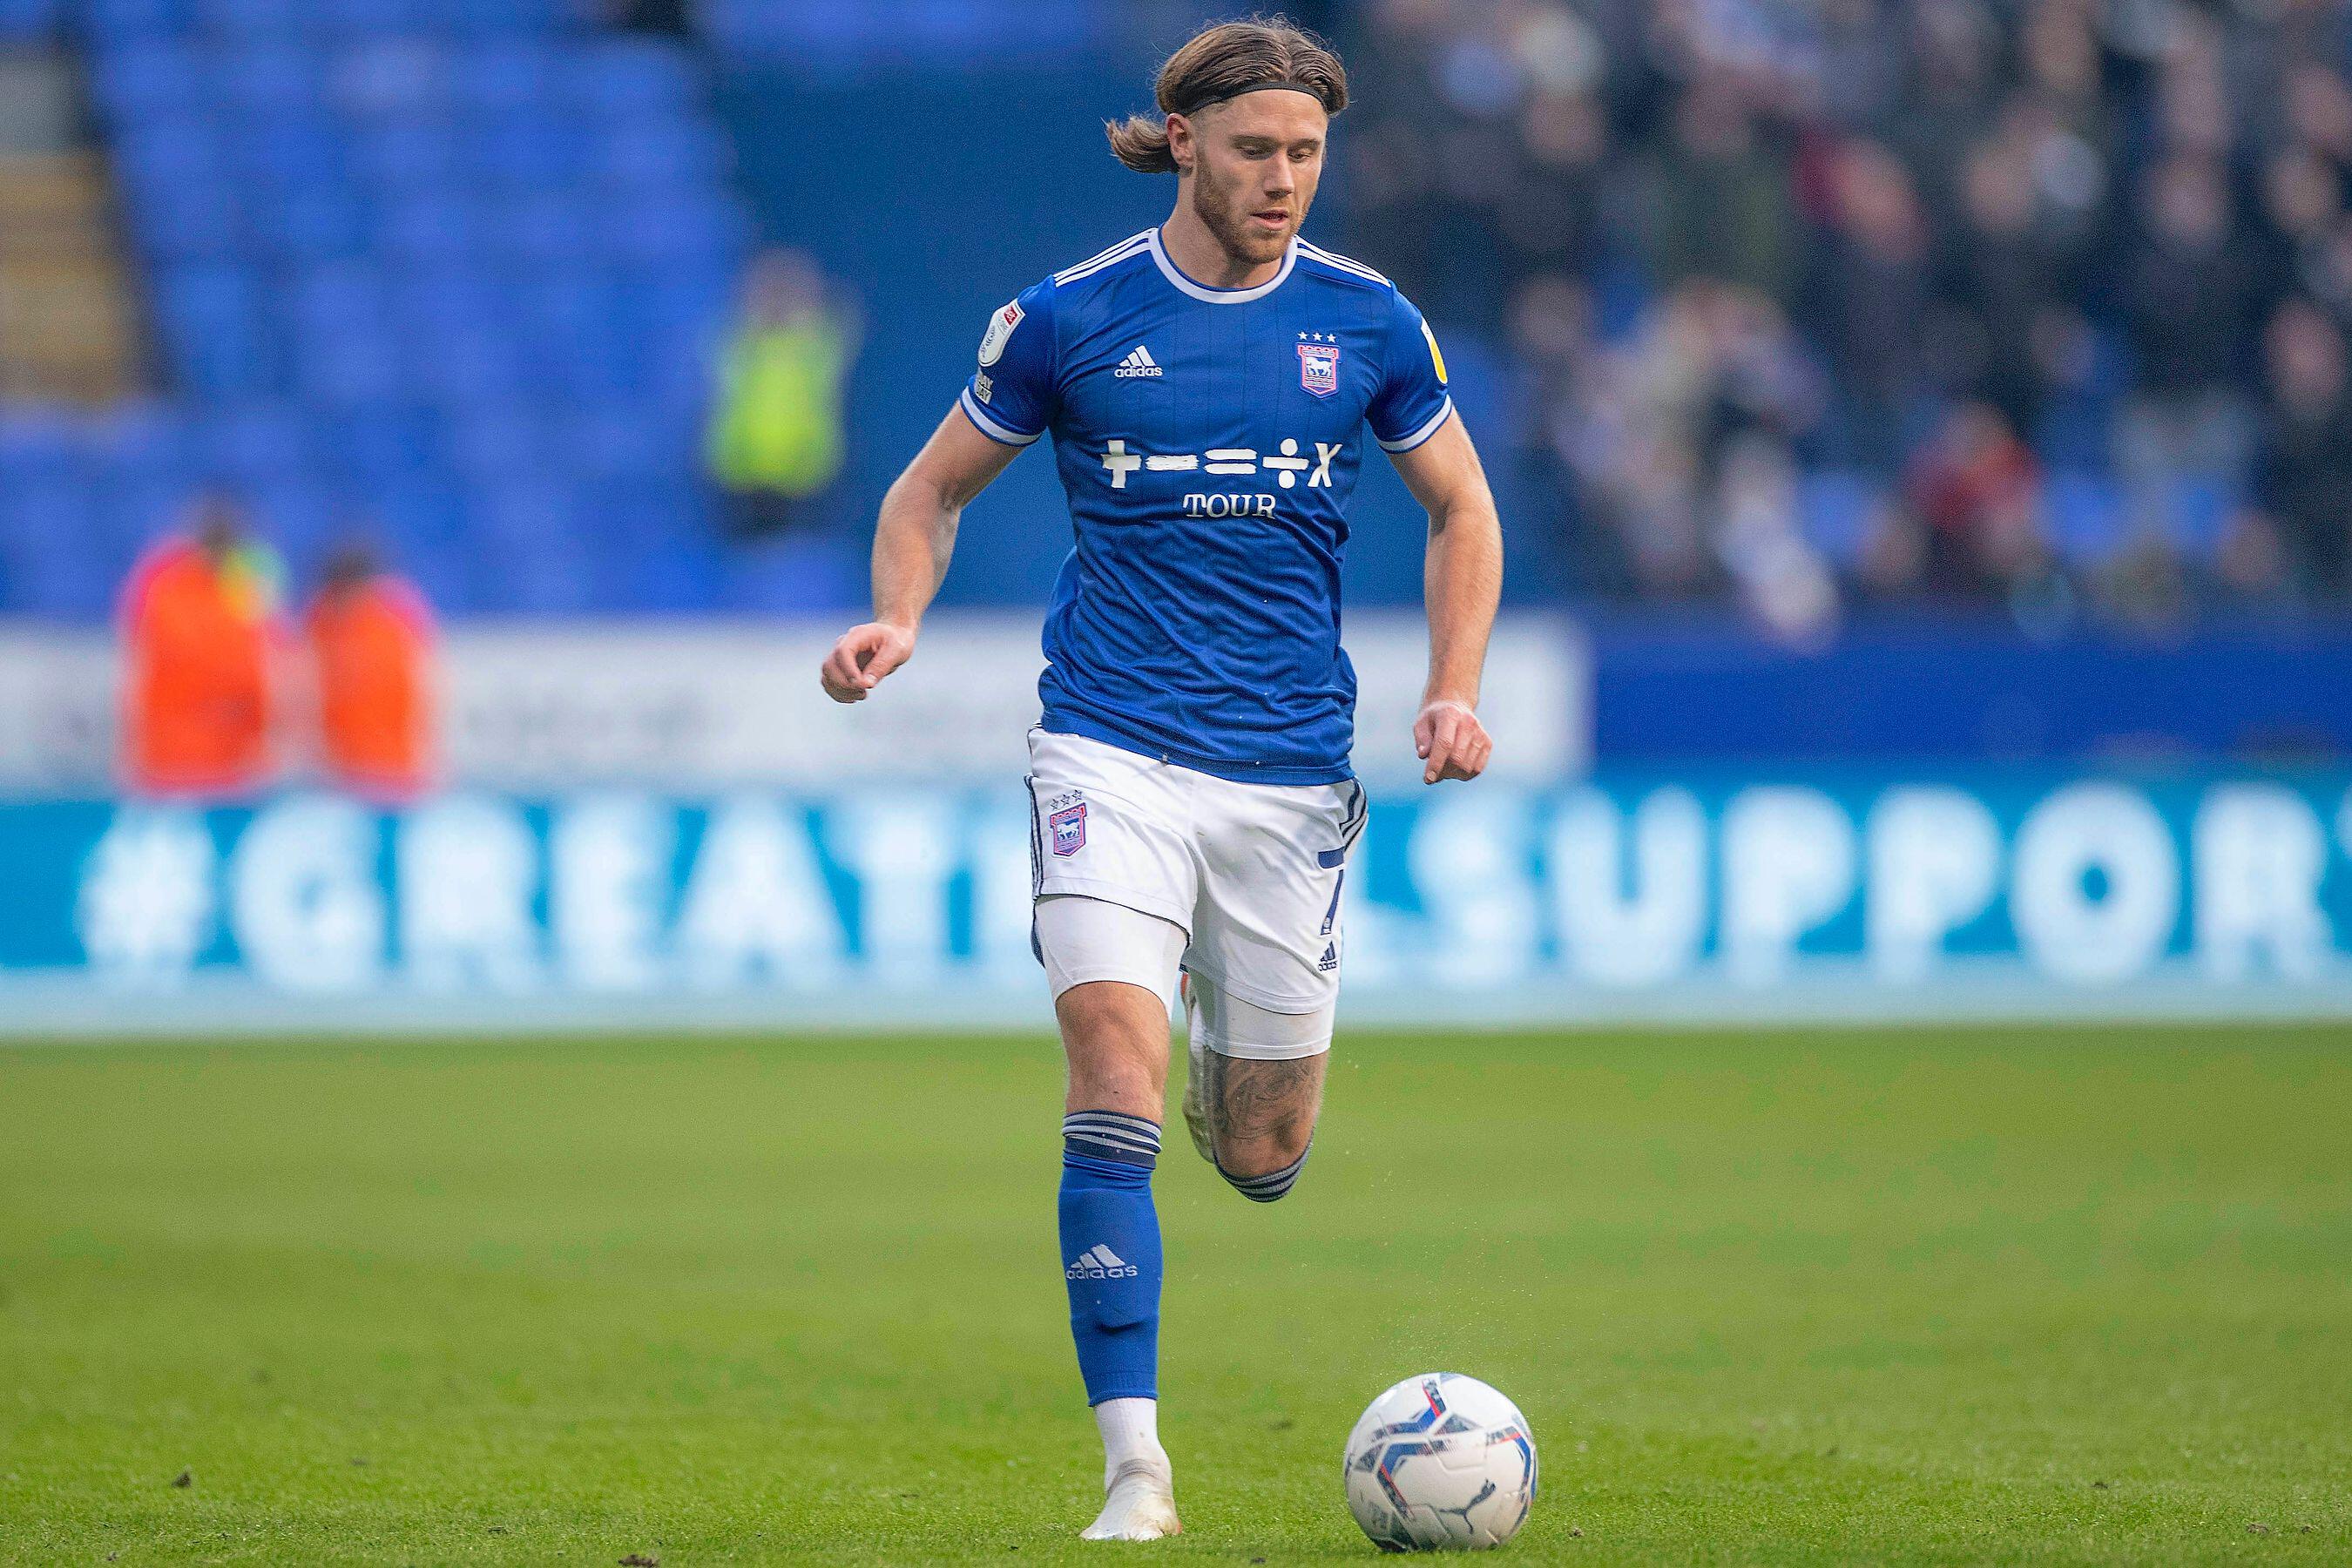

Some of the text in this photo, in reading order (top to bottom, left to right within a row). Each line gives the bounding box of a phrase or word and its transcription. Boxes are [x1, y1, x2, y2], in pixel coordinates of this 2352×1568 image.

[1114, 366, 1163, 378] adidas
[1183, 494, 1276, 519] TOUR
[1065, 1265, 1139, 1280] adidas
